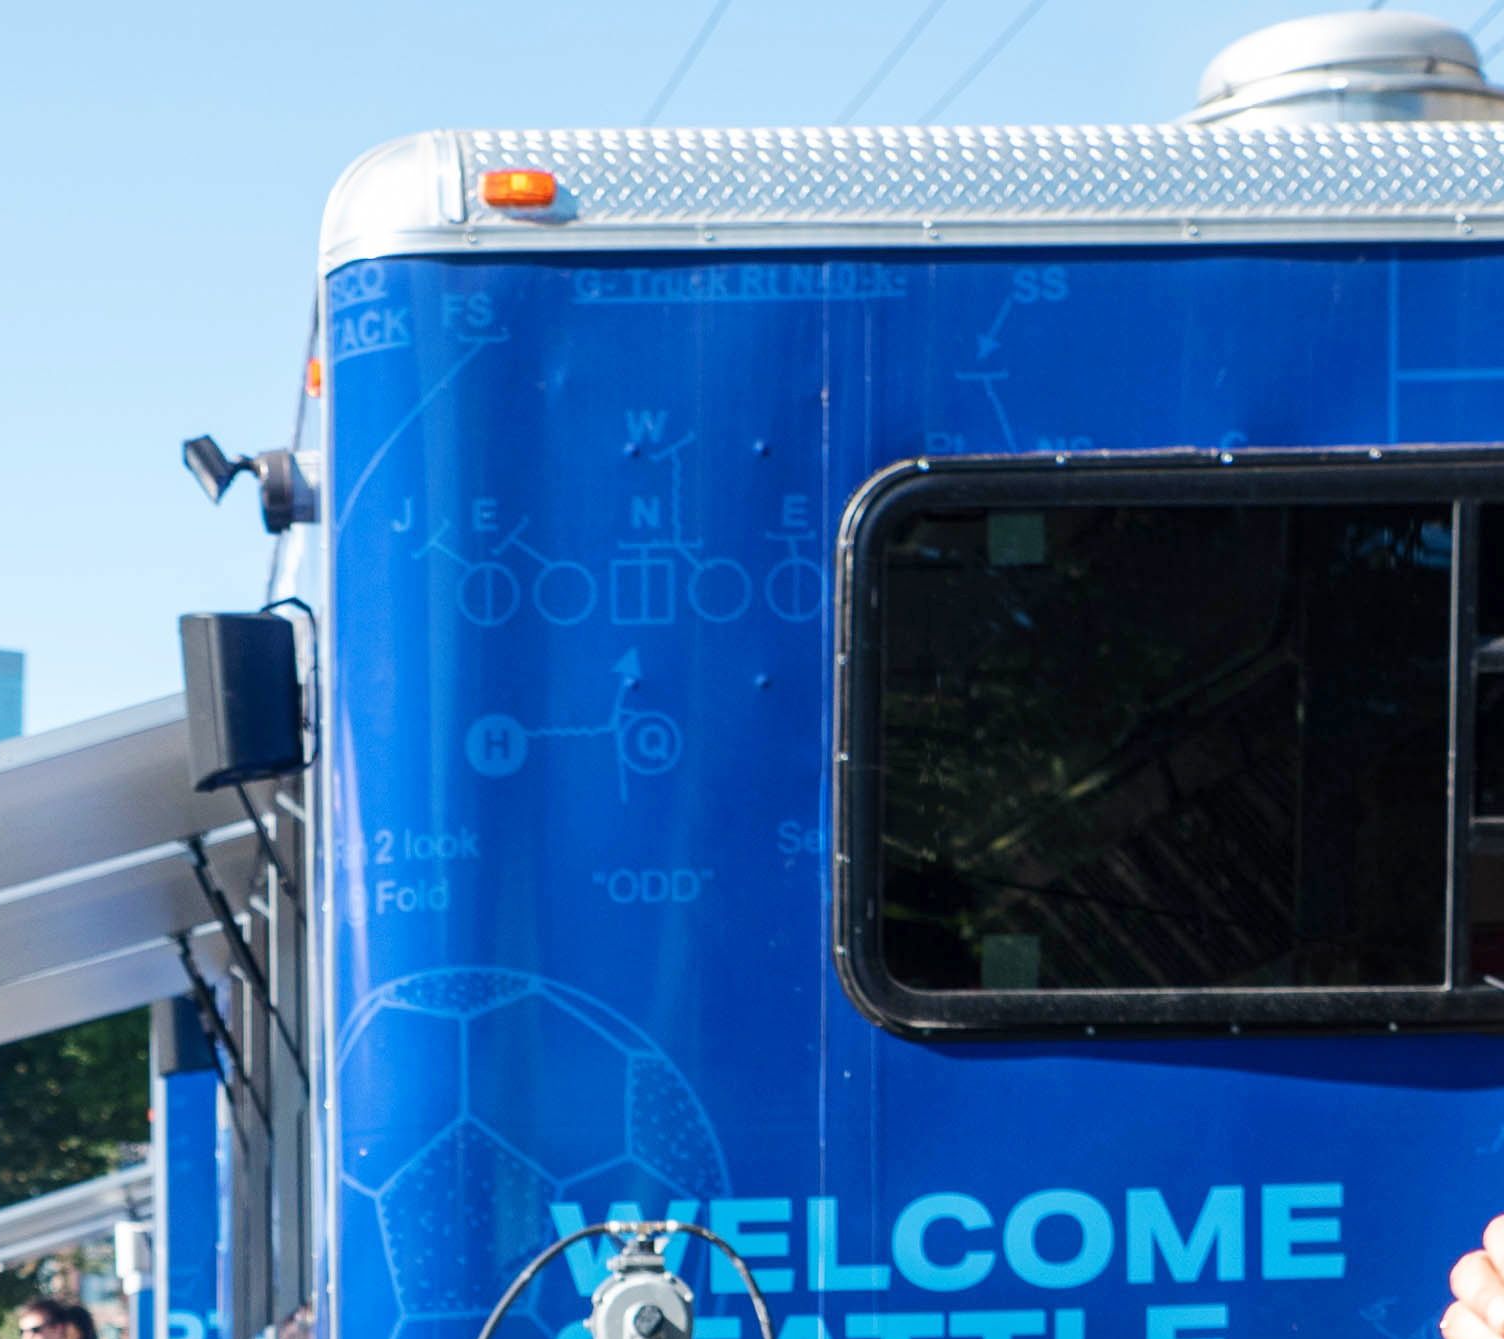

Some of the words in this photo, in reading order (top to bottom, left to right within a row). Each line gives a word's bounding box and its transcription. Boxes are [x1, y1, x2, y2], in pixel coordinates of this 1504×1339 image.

[1012, 265, 1070, 302] SS
[404, 825, 481, 861] look
[375, 878, 451, 914] Fold
[549, 1182, 1346, 1297] WELCOME
